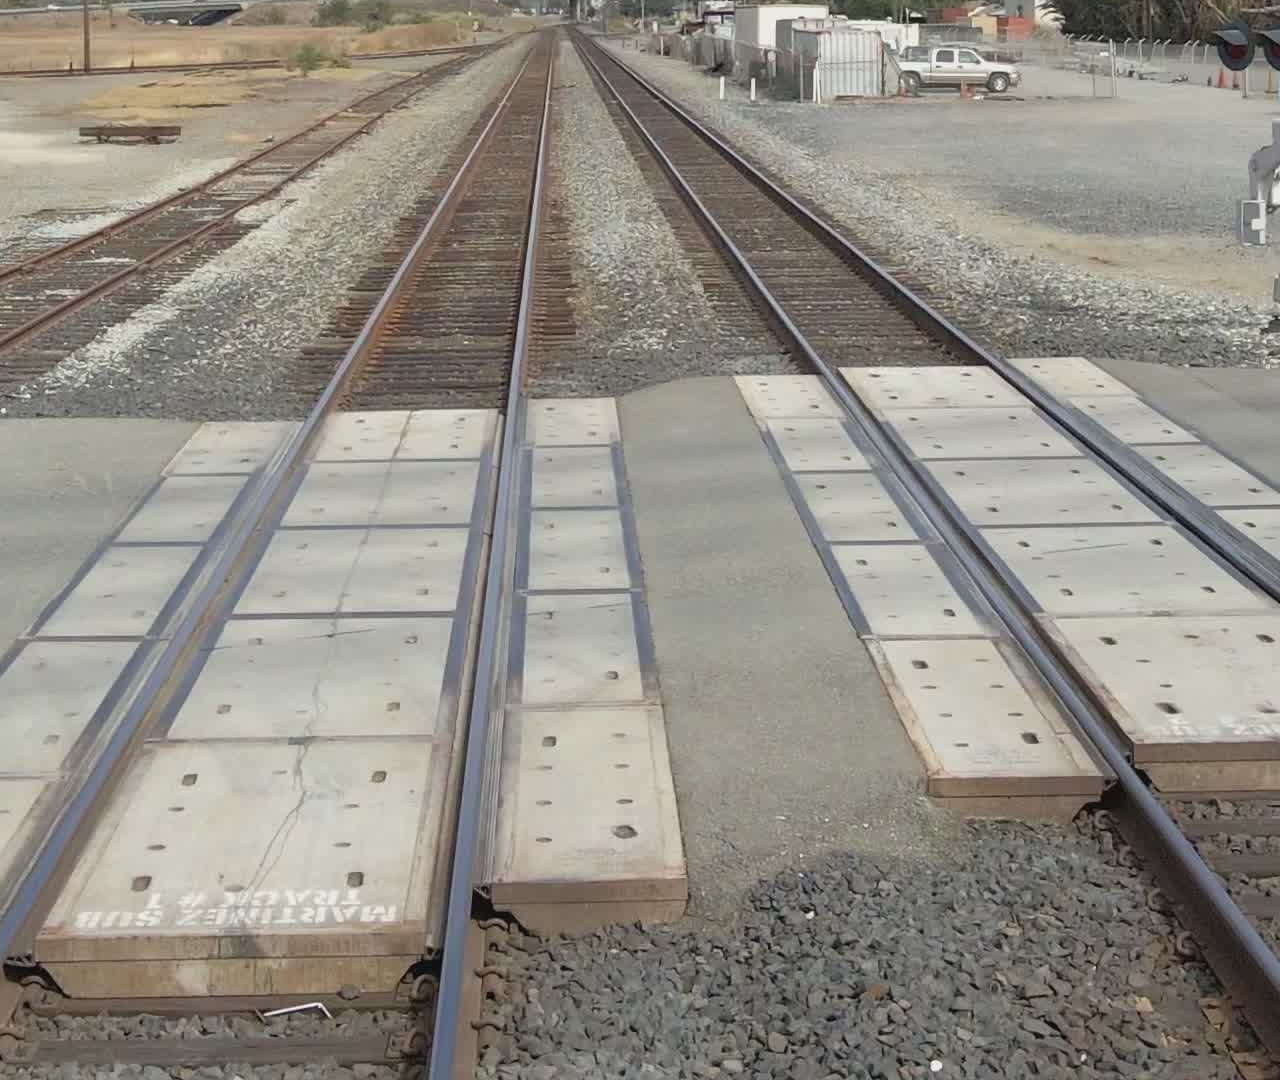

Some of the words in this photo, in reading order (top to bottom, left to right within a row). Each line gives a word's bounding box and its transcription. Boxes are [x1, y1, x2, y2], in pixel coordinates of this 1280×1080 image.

[223, 889, 361, 906] TRACK
[74, 909, 162, 927] SUB
[175, 905, 400, 926] MARTINEZ
